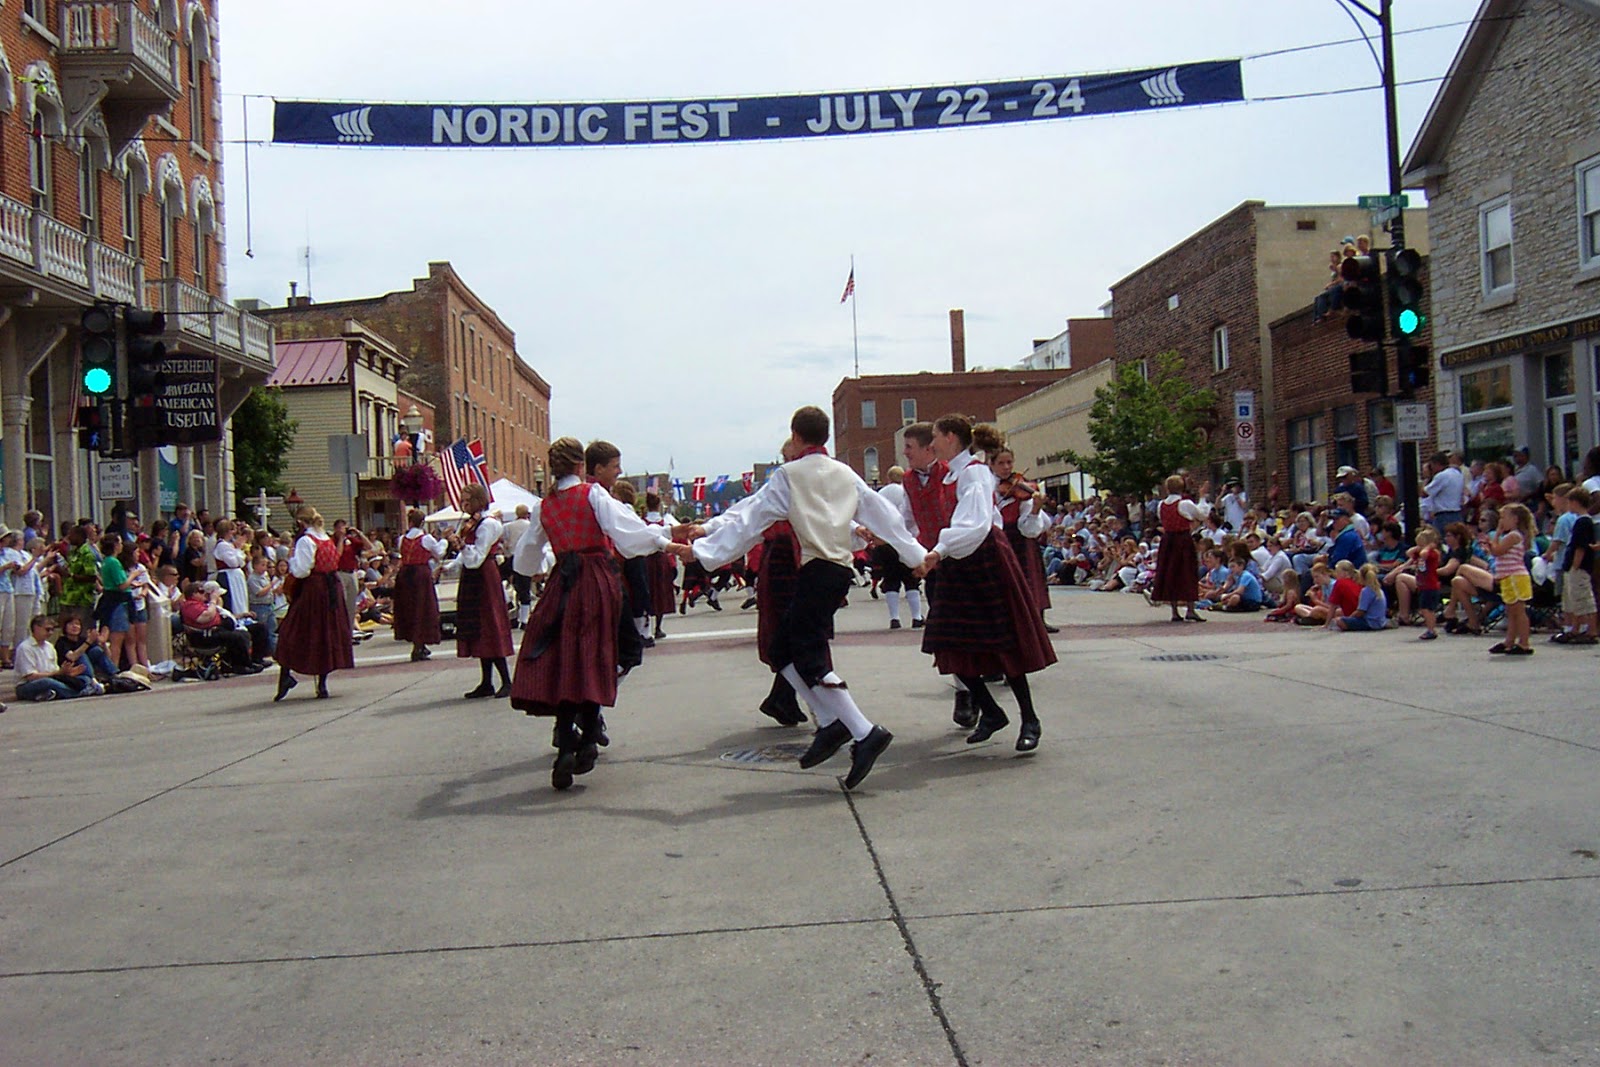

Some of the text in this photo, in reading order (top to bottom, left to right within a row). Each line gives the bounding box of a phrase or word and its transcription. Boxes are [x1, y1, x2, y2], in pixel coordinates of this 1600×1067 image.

[432, 105, 608, 144] NORDIC
[624, 101, 739, 141] FEST
[806, 91, 922, 134] JULY
[937, 87, 991, 126] 22
[1031, 79, 1086, 118] 24
[161, 359, 215, 374] ESTERHEIM
[163, 382, 215, 397] RWEGIAN
[156, 398, 215, 410] AMERICAN
[167, 411, 216, 428] USEUM
[109, 464, 121, 472] NO
